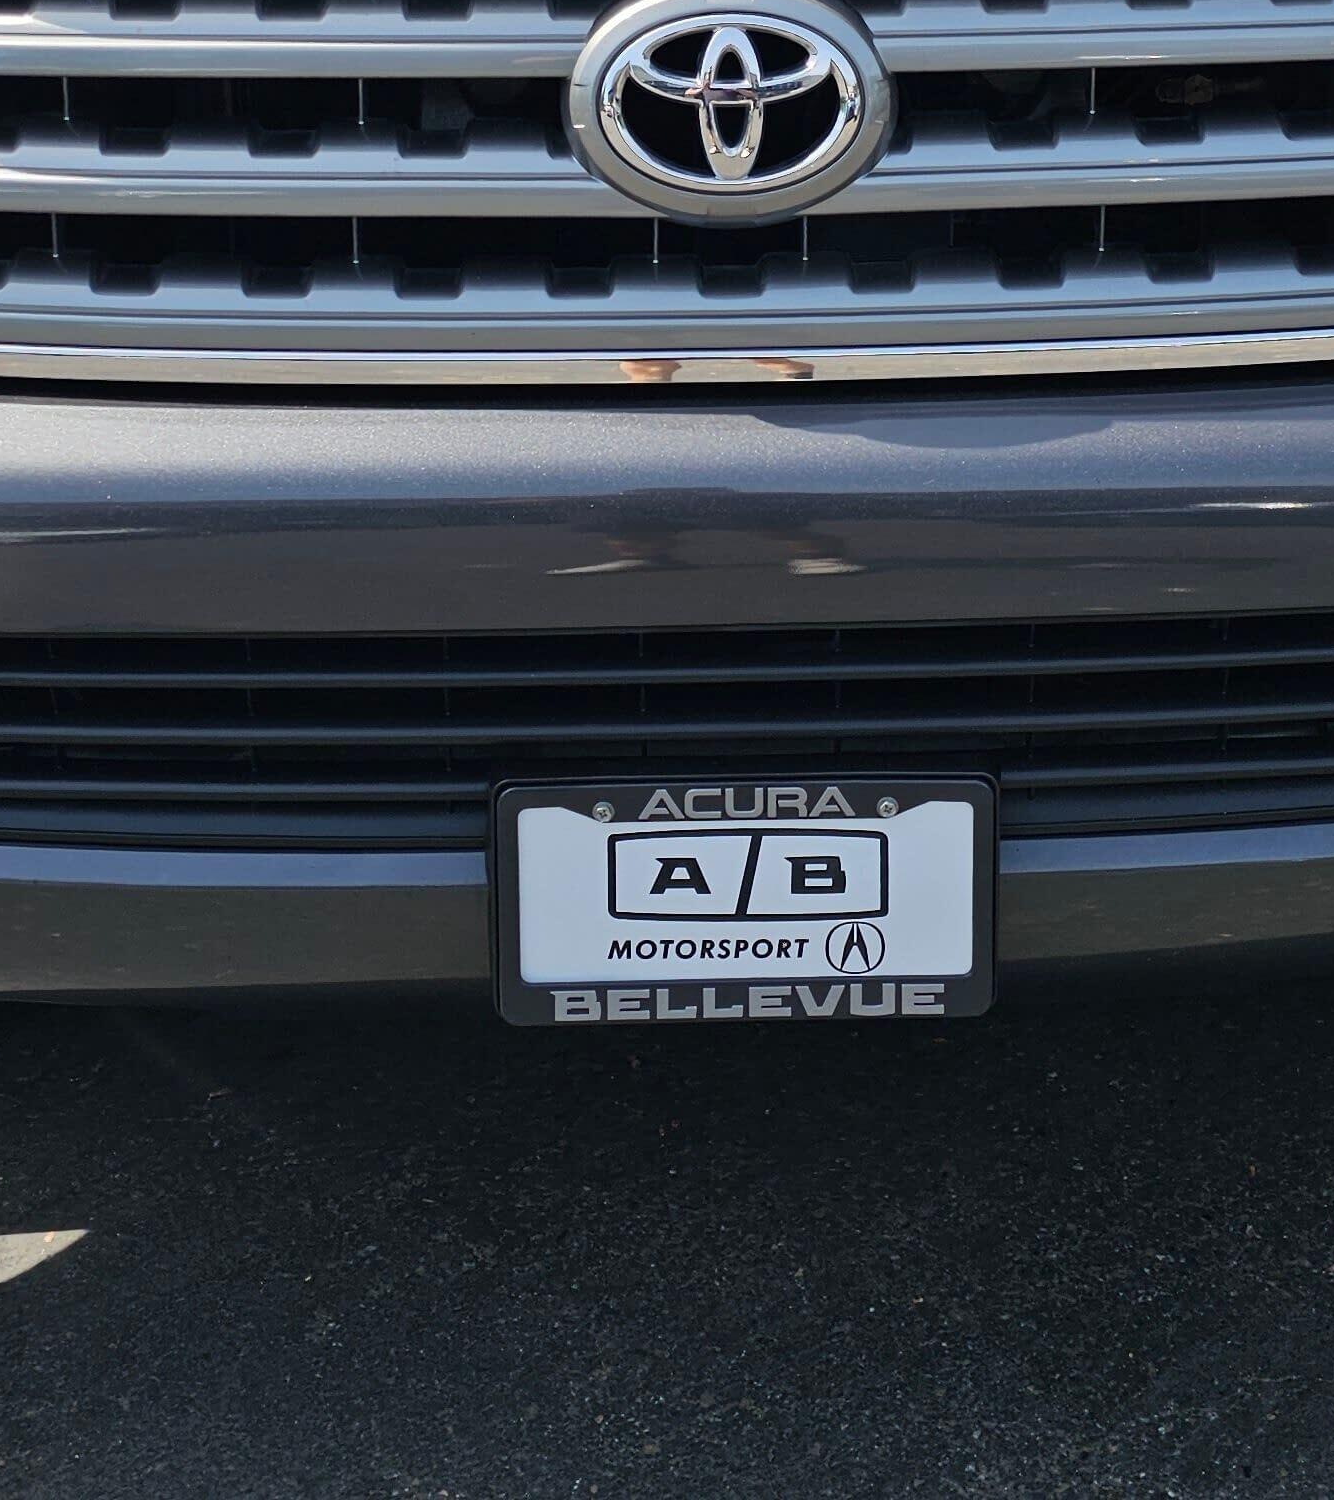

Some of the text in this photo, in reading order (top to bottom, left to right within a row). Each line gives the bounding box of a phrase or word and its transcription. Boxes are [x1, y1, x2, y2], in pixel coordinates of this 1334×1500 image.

[638, 786, 857, 821] ACURA
[607, 938, 810, 960] MOTORSPORT
[550, 983, 946, 1022] BELLEVUE
